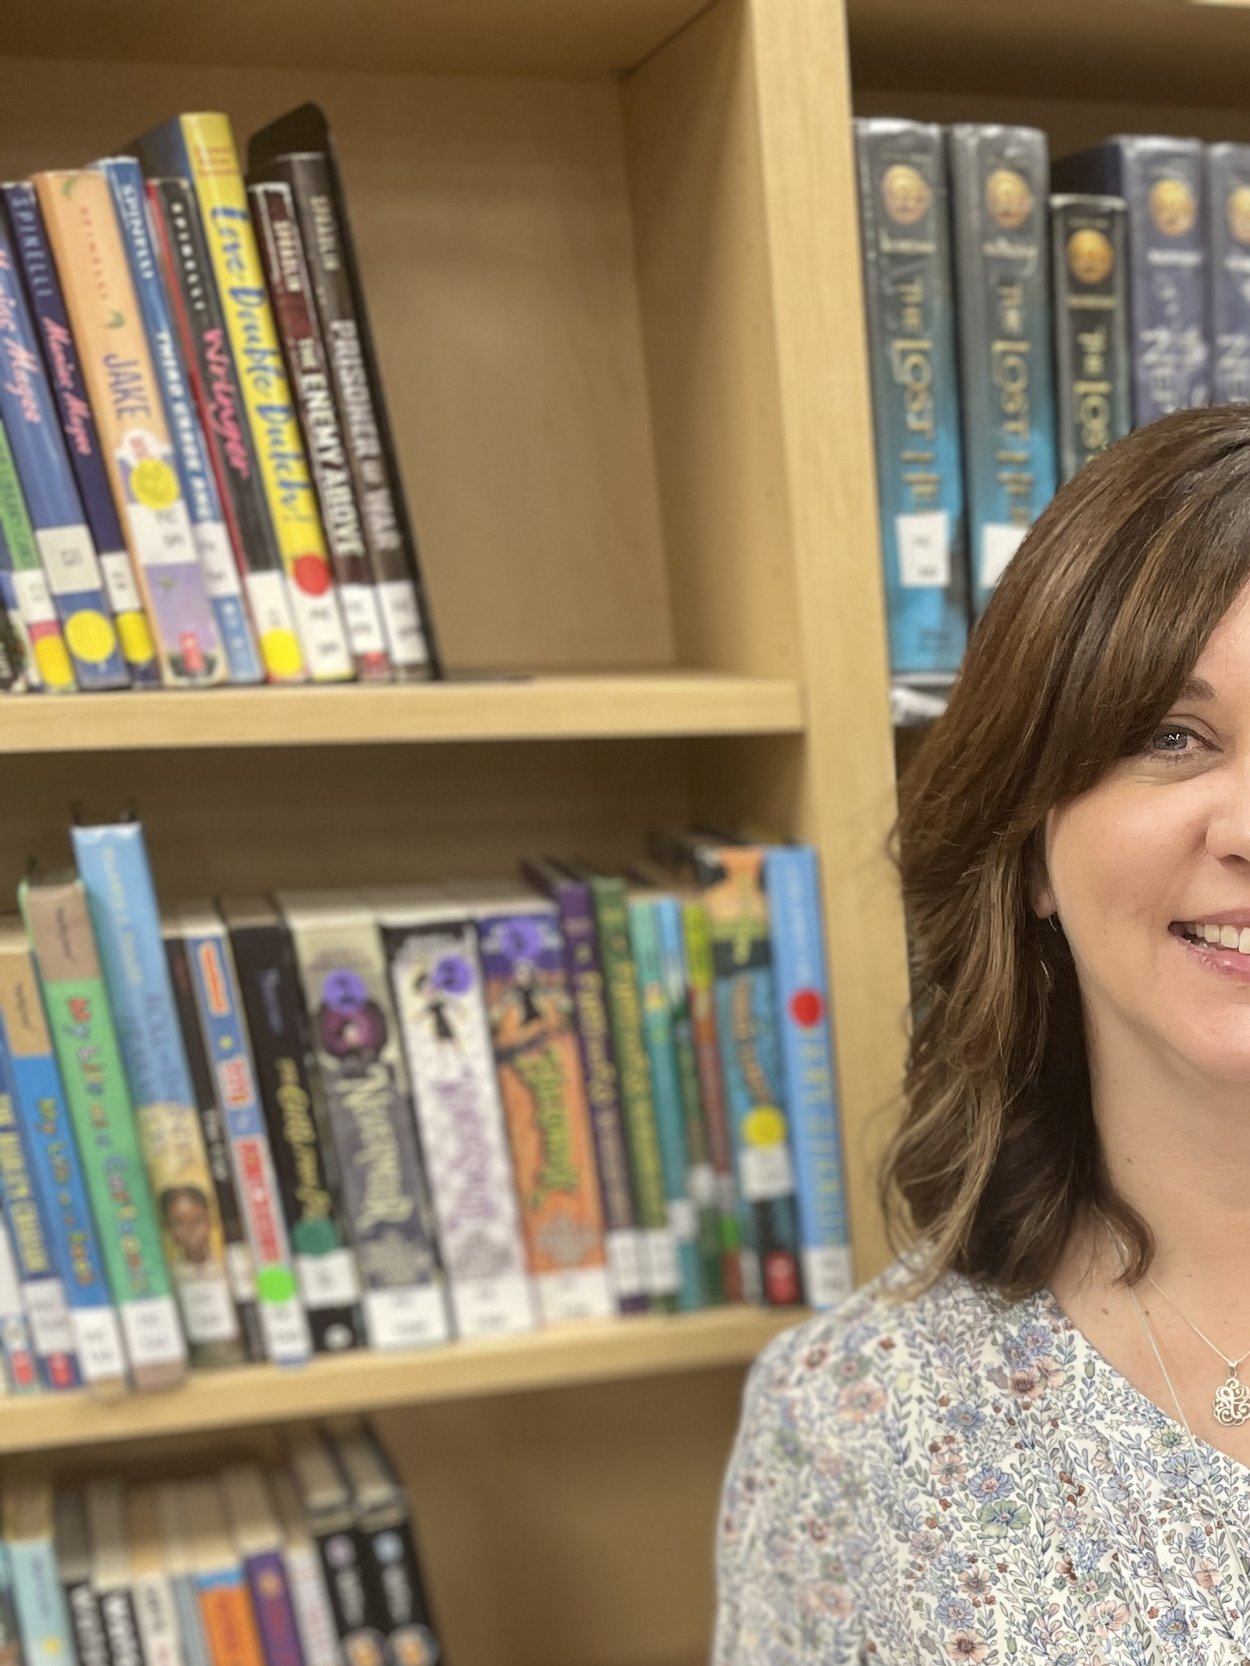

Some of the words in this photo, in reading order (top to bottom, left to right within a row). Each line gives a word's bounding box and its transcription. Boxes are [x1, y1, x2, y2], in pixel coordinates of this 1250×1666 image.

[12, 196, 53, 296] SPINELLI
[122, 184, 155, 279] SPINELLI
[102, 353, 151, 420] JAKE
[155, 331, 183, 397] THIRD
[227, 286, 286, 395] Double
[890, 338, 935, 439] LOST
[203, 327, 250, 479] Wringer
[303, 371, 345, 465] ENEMY
[329, 319, 381, 457] PRISONER
[364, 487, 404, 549] WAR
[991, 340, 1030, 442] LOST
[1072, 379, 1112, 462] LOS
[323, 466, 365, 557] ABOVE
